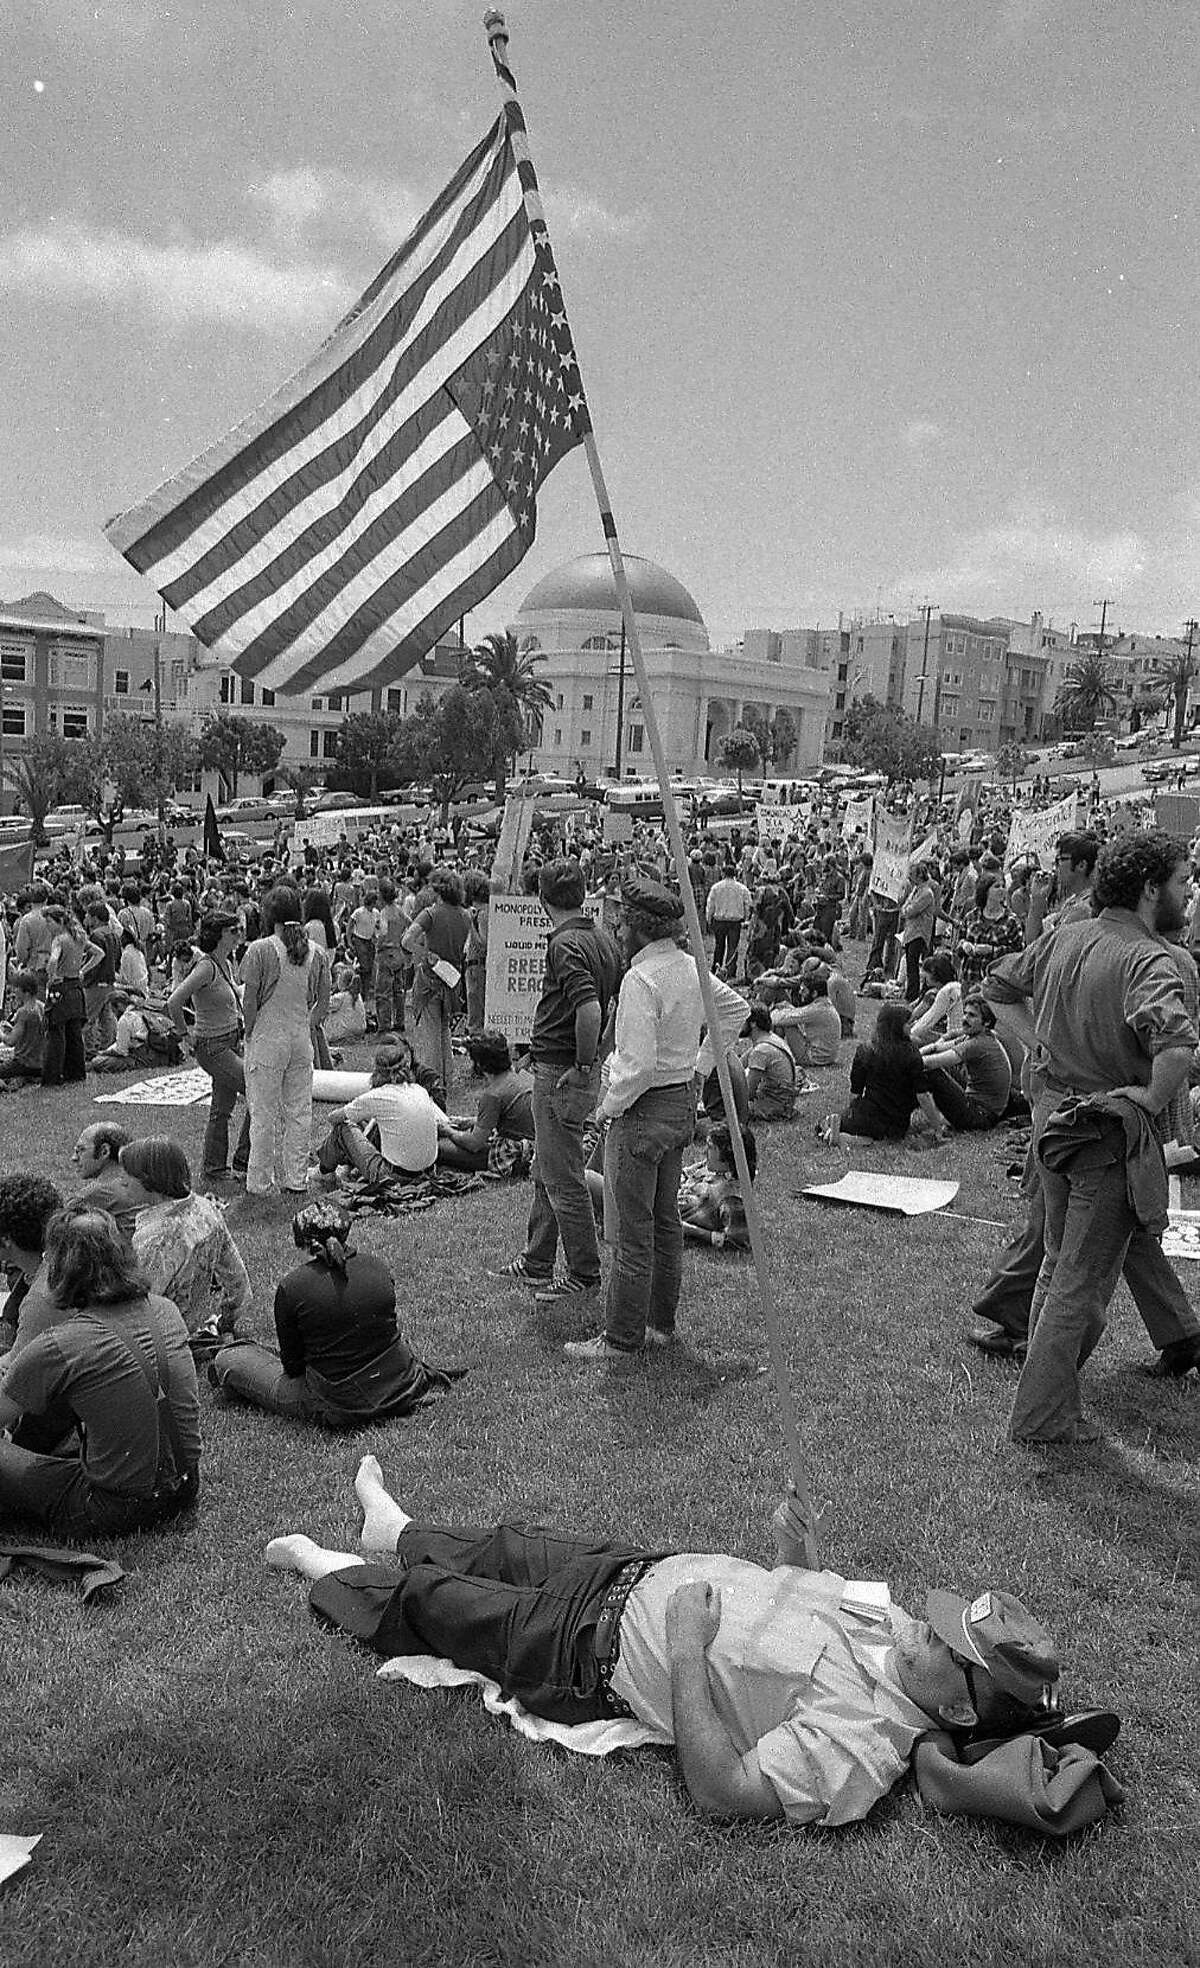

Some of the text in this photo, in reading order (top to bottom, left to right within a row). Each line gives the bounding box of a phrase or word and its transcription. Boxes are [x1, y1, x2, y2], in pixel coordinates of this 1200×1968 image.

[495, 903, 542, 915] MONOPOLY
[519, 916, 554, 928] PRESE
[508, 958, 547, 974] BREE
[507, 977, 543, 993] REAC
